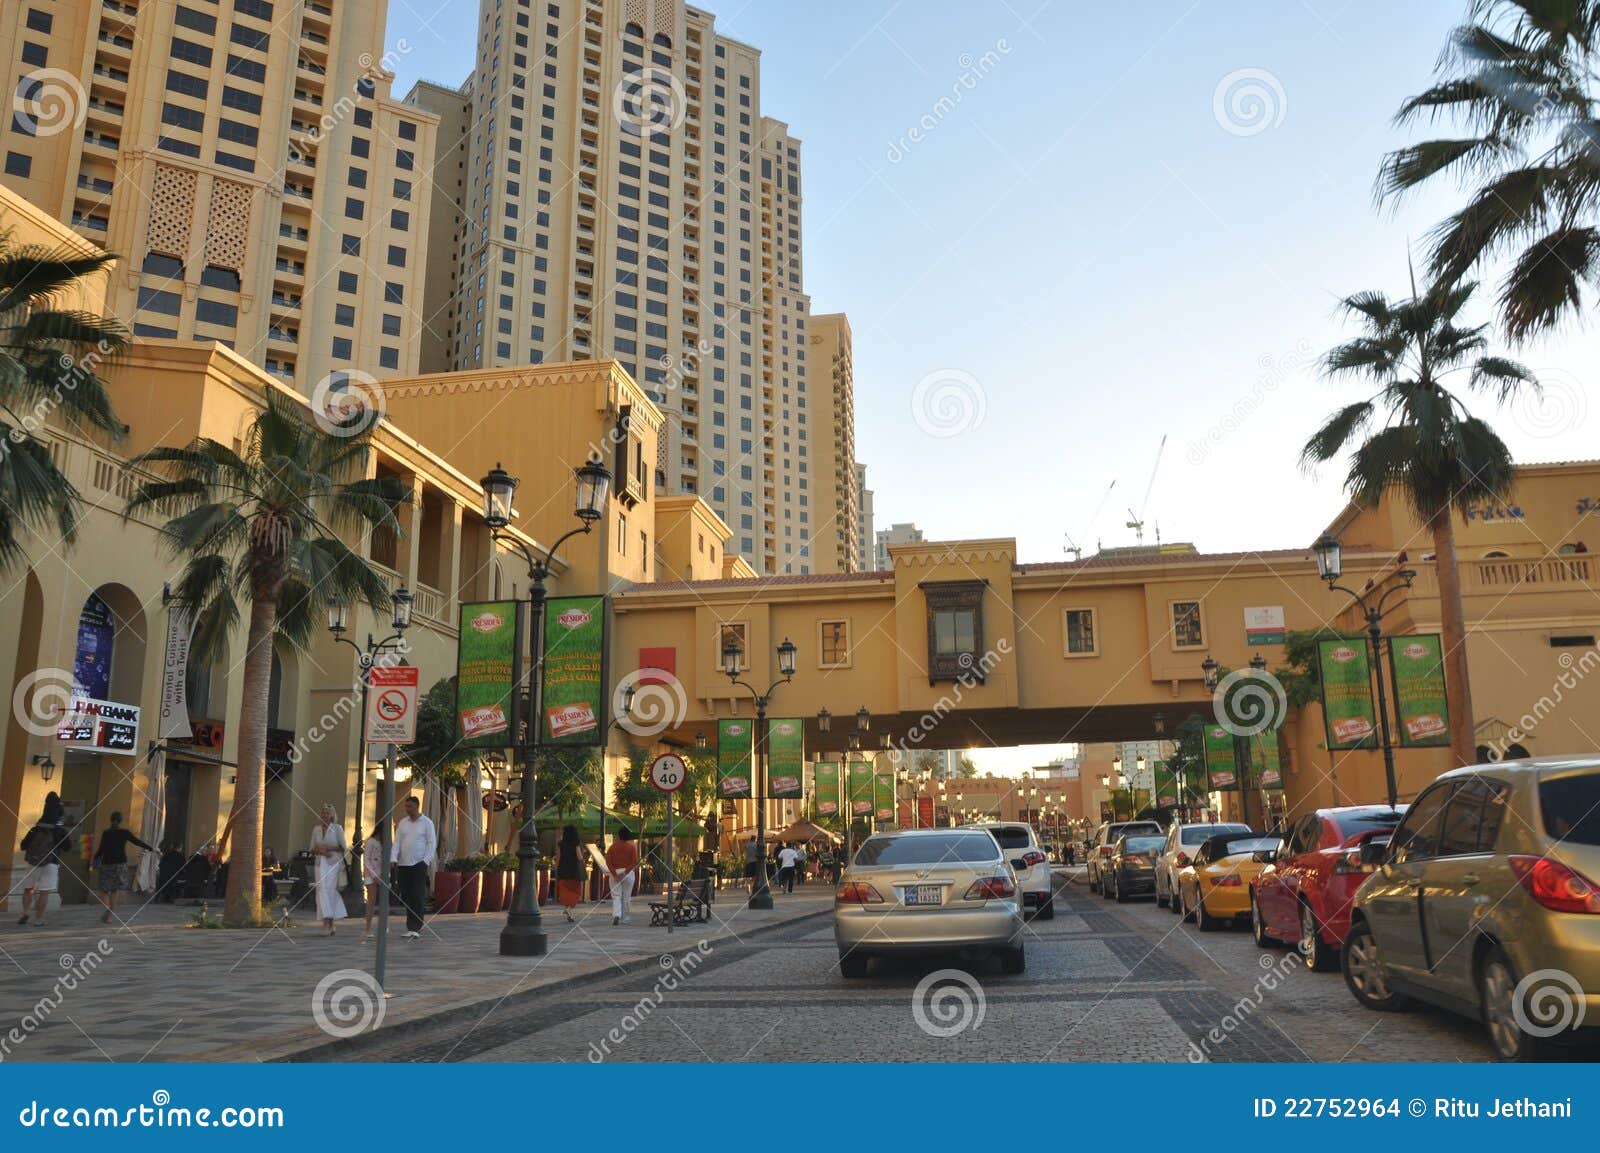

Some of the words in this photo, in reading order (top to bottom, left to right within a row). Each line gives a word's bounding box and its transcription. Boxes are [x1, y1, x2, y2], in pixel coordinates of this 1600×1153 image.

[166, 626, 178, 667] Cuisine
[162, 671, 174, 718] Oriental
[175, 679, 184, 704] with
[76, 701, 138, 721] RAKBANK
[660, 773, 677, 785] 40
